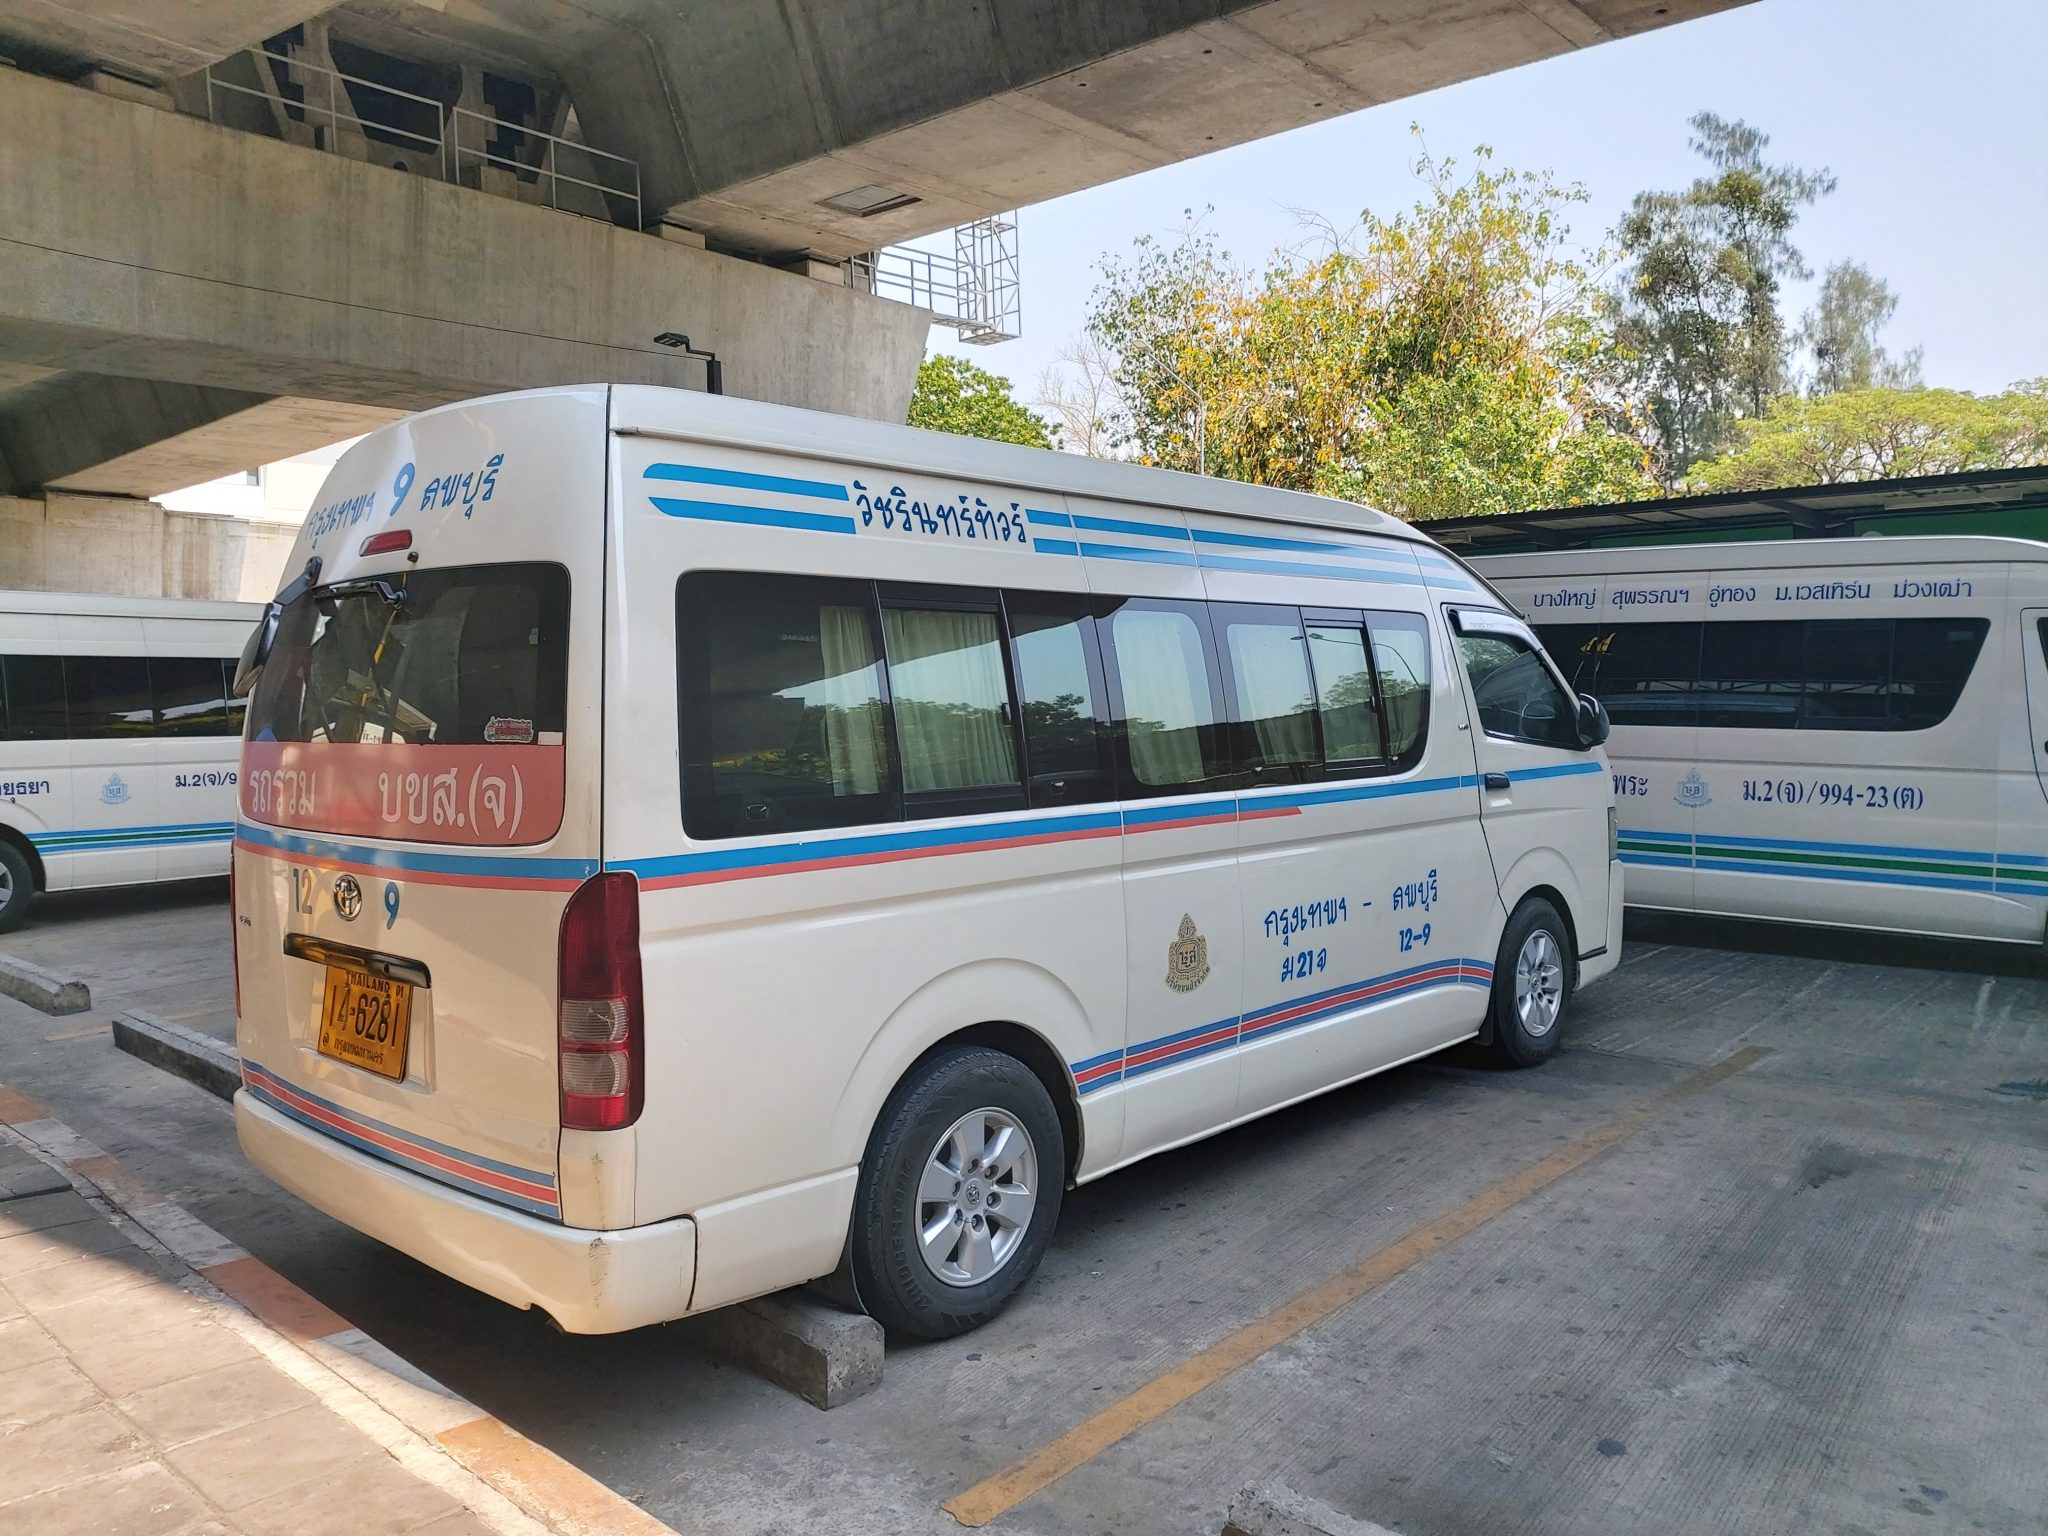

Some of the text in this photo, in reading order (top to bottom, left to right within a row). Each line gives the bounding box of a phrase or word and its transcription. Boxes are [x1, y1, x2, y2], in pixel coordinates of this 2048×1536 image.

[390, 462, 416, 517] 9
[1533, 587, 1597, 609] บางใหญ่
[1612, 588, 1690, 610] สุพรรณฯ
[1709, 585, 1756, 607] อู่ทอง
[0, 780, 50, 804] ยุธยา
[293, 868, 400, 930] 12 9
[1399, 923, 1432, 953] 12-9
